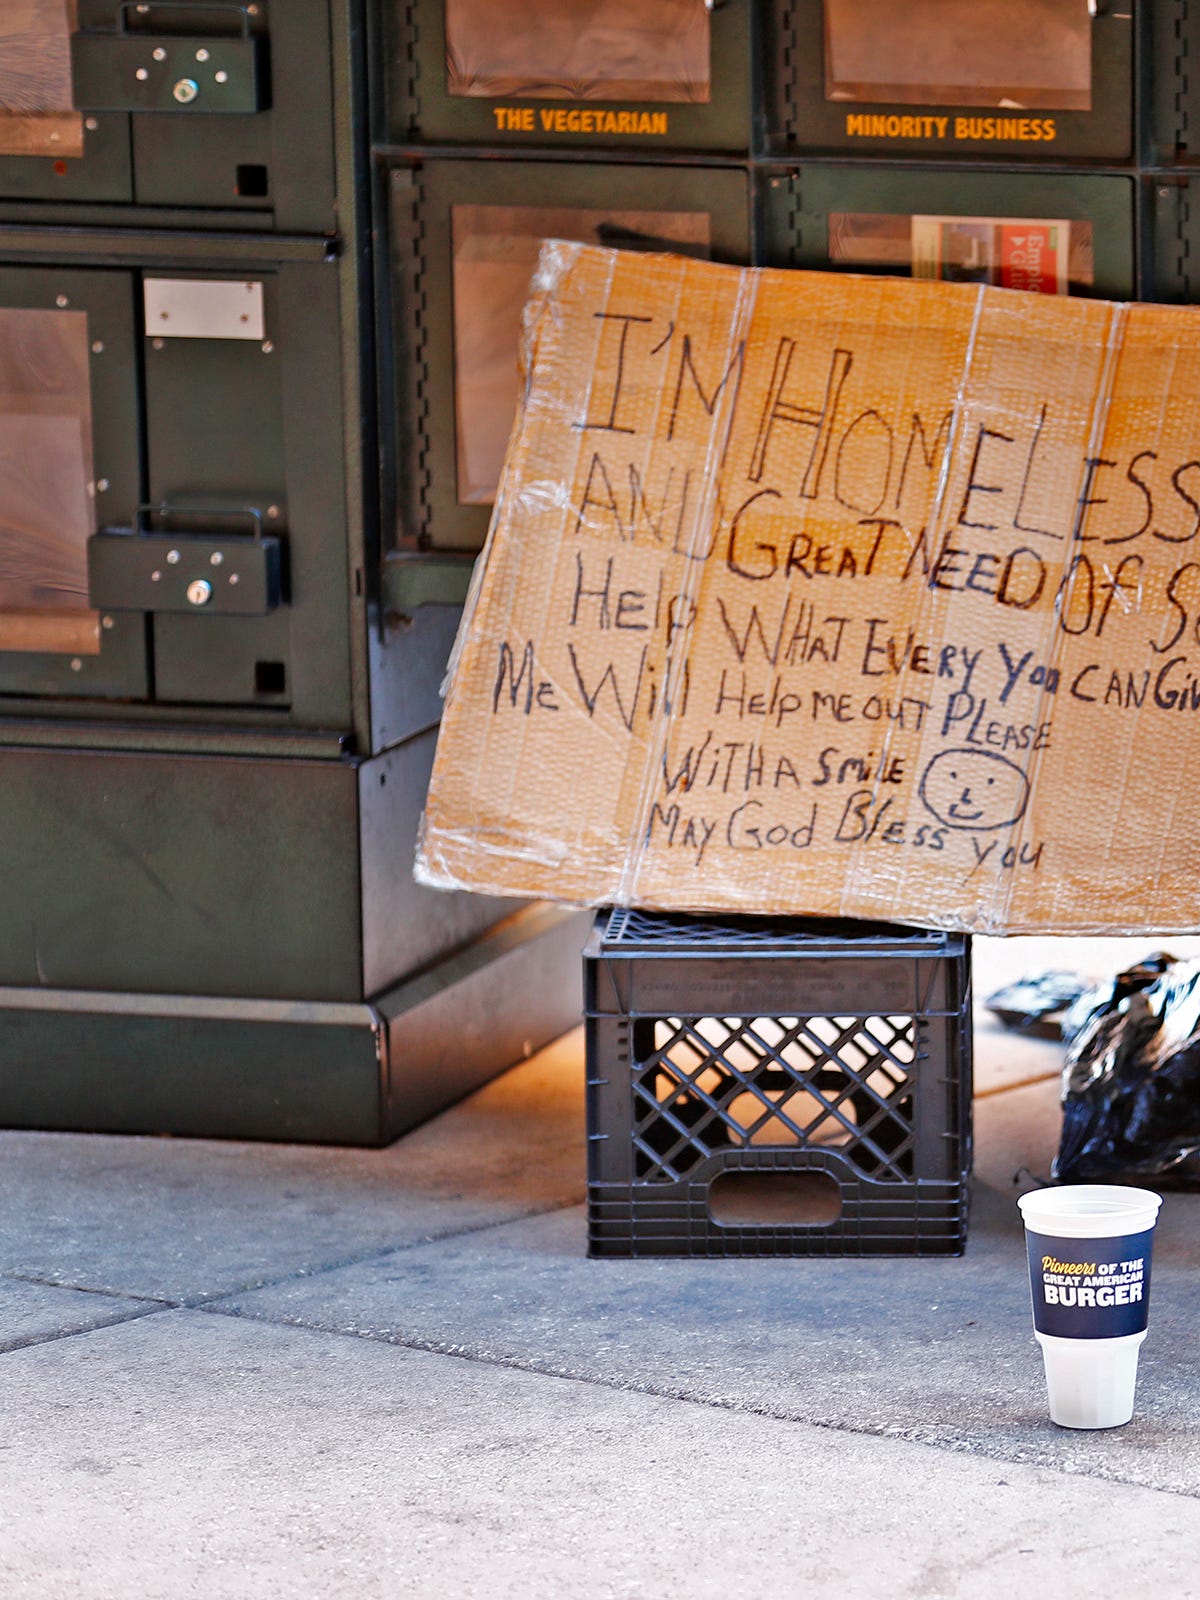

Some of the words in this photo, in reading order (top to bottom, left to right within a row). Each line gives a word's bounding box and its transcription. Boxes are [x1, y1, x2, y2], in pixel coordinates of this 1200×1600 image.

[493, 107, 535, 131] THE
[539, 108, 668, 134] VEGETARIAN
[846, 113, 949, 138] MINORITY
[954, 117, 1056, 141] BUSINESS
[571, 313, 746, 468] I'M
[574, 452, 724, 561] AND
[727, 488, 903, 580] GREAT
[902, 526, 1047, 610] NEED
[716, 592, 851, 667] WHAT
[1070, 664, 1151, 708] CAN
[941, 690, 1053, 750] PLEASE
[1042, 1256, 1097, 1275] Pioneers
[1098, 1263, 1118, 1275] OF
[1120, 1258, 1144, 1273] THE
[1043, 1273, 1081, 1286] GREAT
[1083, 1270, 1144, 1286] AMERICAN
[1044, 1282, 1143, 1307] BURGER
